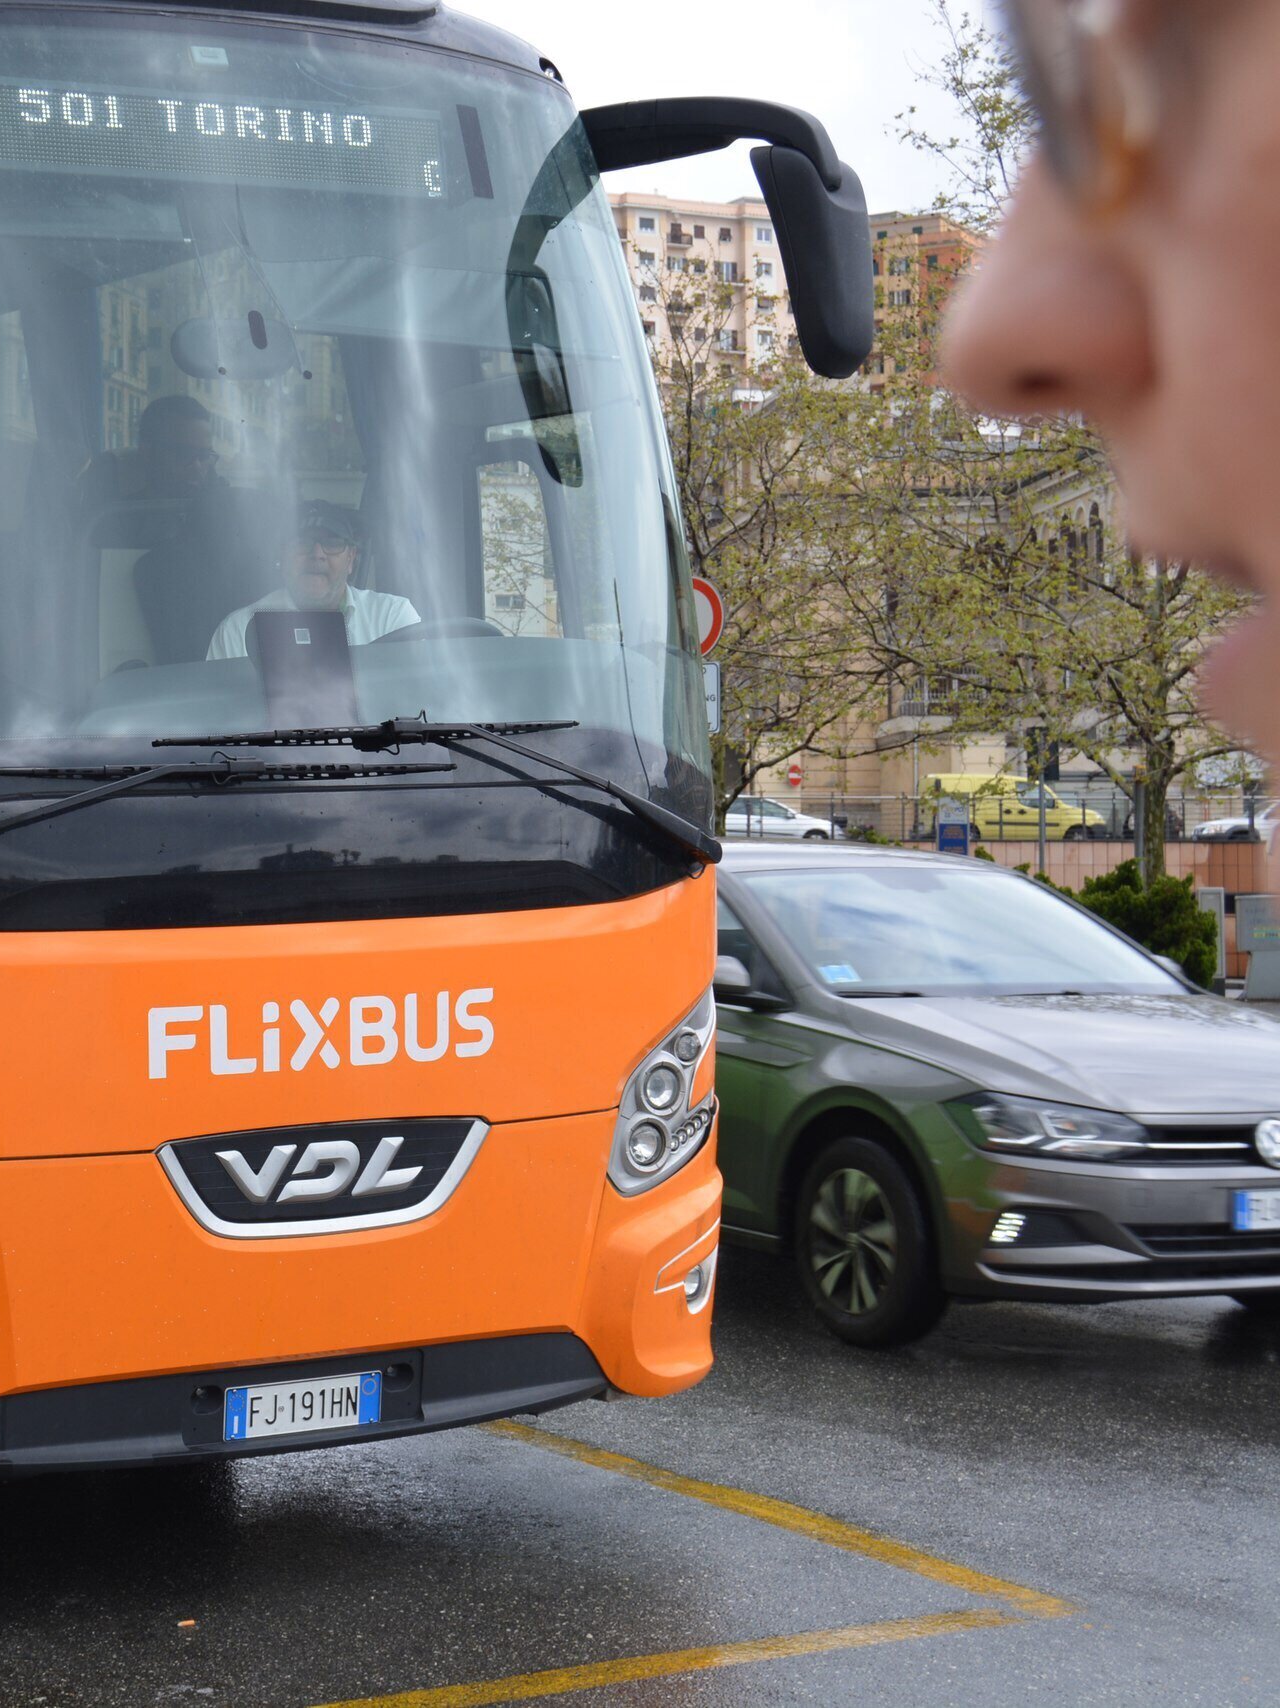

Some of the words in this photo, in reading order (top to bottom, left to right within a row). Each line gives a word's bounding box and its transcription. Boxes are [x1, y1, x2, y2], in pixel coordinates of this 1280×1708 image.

[19, 88, 122, 129] 501
[158, 99, 372, 147] TORINO
[214, 1136, 423, 1203] VDL
